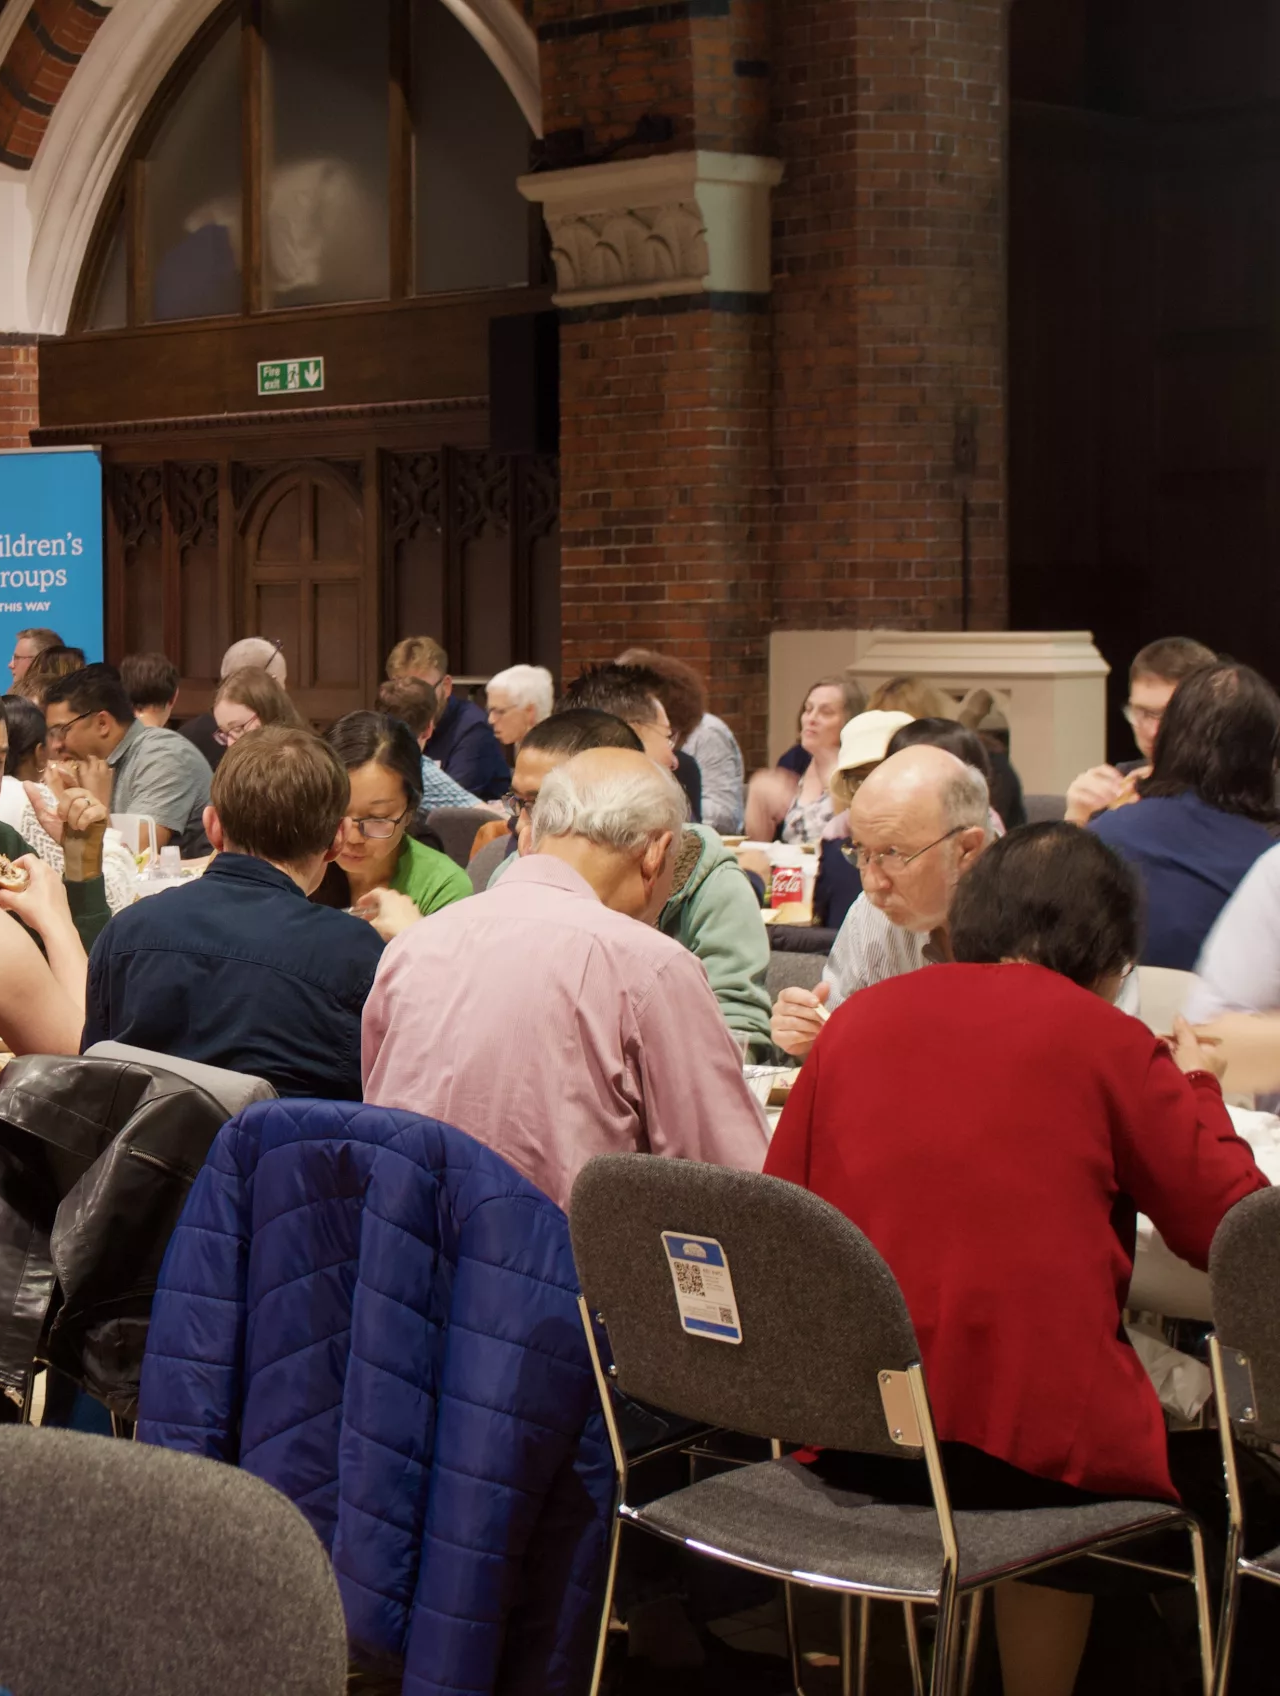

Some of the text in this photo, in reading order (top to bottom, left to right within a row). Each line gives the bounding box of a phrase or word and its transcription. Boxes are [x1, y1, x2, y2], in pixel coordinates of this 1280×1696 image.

[263, 366, 280, 377] Fire
[264, 379, 280, 390] exit
[24, 601, 51, 612] WAY
